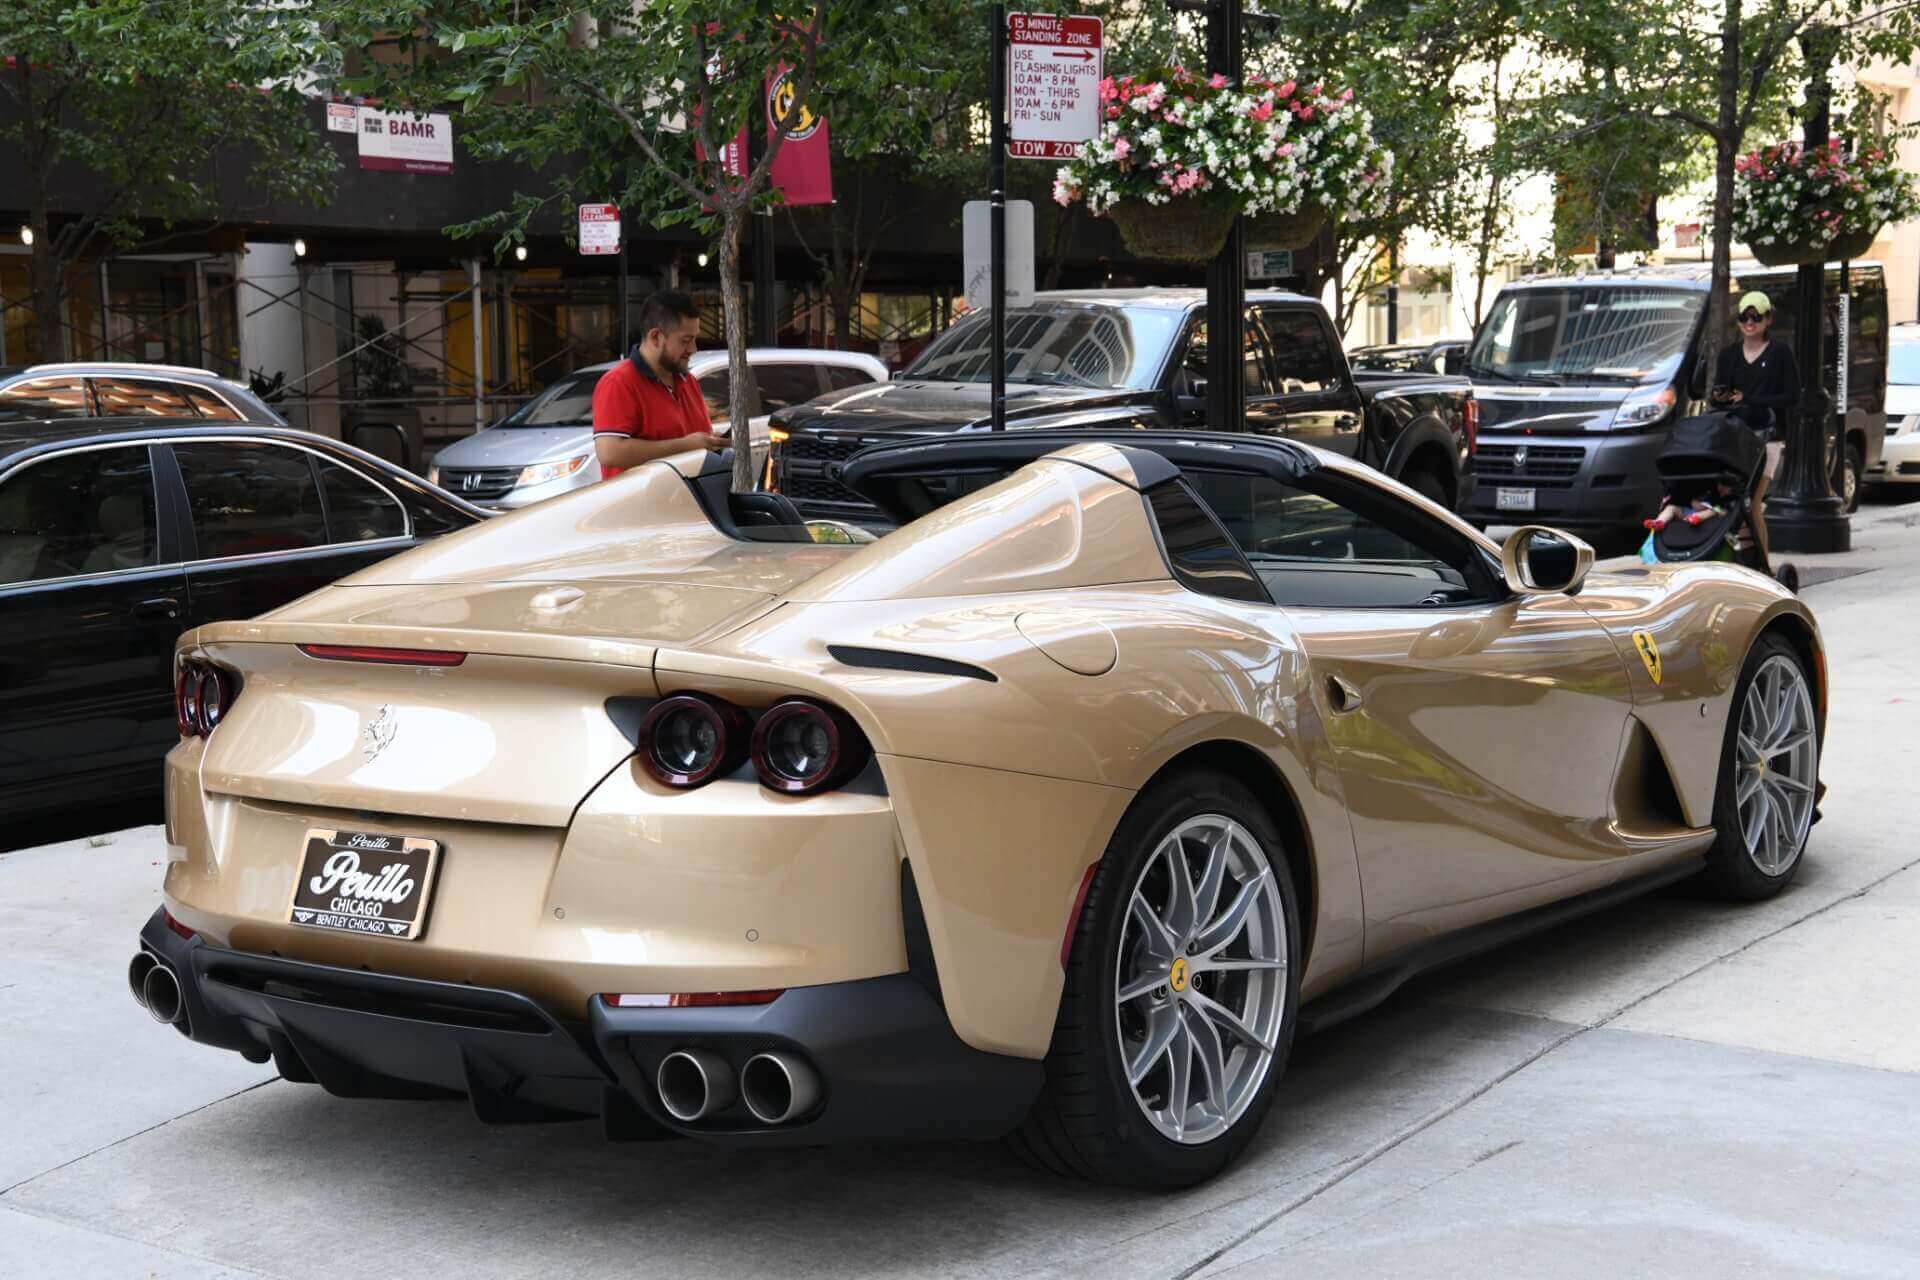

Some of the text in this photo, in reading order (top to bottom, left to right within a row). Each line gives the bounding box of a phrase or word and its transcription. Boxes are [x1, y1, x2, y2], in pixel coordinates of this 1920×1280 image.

[1015, 19, 1024, 28] 15
[1015, 31, 1092, 44] STANDING ZONE
[1015, 50, 1034, 60] USE
[1015, 62, 1097, 75] FLASHING LIGHTS
[1052, 76, 1058, 85] 8
[1061, 76, 1076, 86] PM
[1015, 87, 1036, 97] MON
[1048, 88, 1080, 98] THURS
[1051, 99, 1058, 109] 6
[1060, 100, 1075, 110] PM
[1015, 110, 1030, 120] FRI
[1040, 111, 1061, 121] SUN
[389, 119, 435, 139] BAMR
[1015, 141, 1046, 155] TOW
[347, 833, 390, 849] Perillo
[310, 850, 415, 904] Perillo
[330, 897, 383, 917] CHICAGO
[316, 914, 385, 933] BENTLEY CHICAGO
